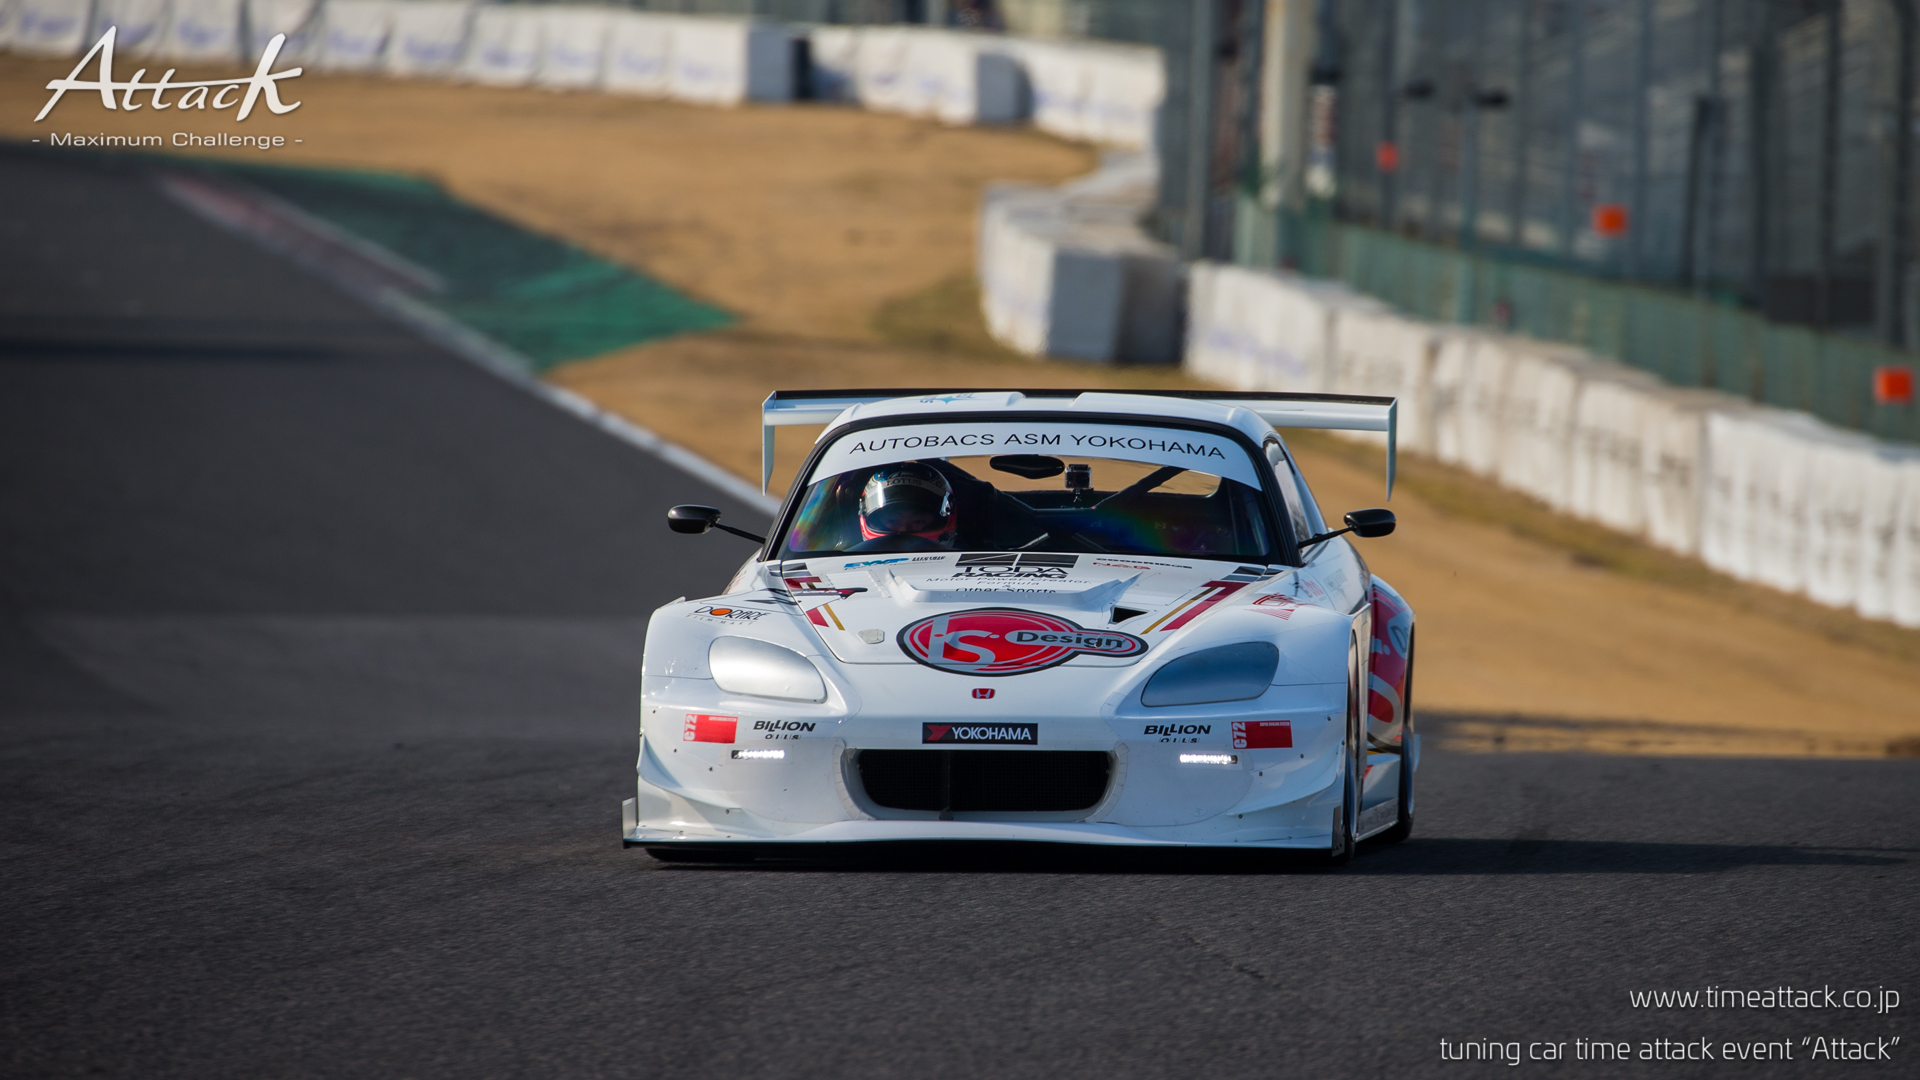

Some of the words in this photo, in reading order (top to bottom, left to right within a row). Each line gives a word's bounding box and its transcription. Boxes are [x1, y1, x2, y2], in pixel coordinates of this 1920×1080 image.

[849, 433, 995, 455] AUTOBACS
[1004, 433, 1061, 446] ASM
[1070, 434, 1226, 460] YOKOHAMA
[887, 478, 922, 486] LOTUS
[964, 566, 1068, 574] TODA
[1016, 631, 1123, 649] Design
[753, 720, 816, 732] BILLION
[1144, 724, 1211, 736] BILLION
[952, 727, 1032, 740] YOKOHAMA
[1232, 722, 1247, 749] C72
